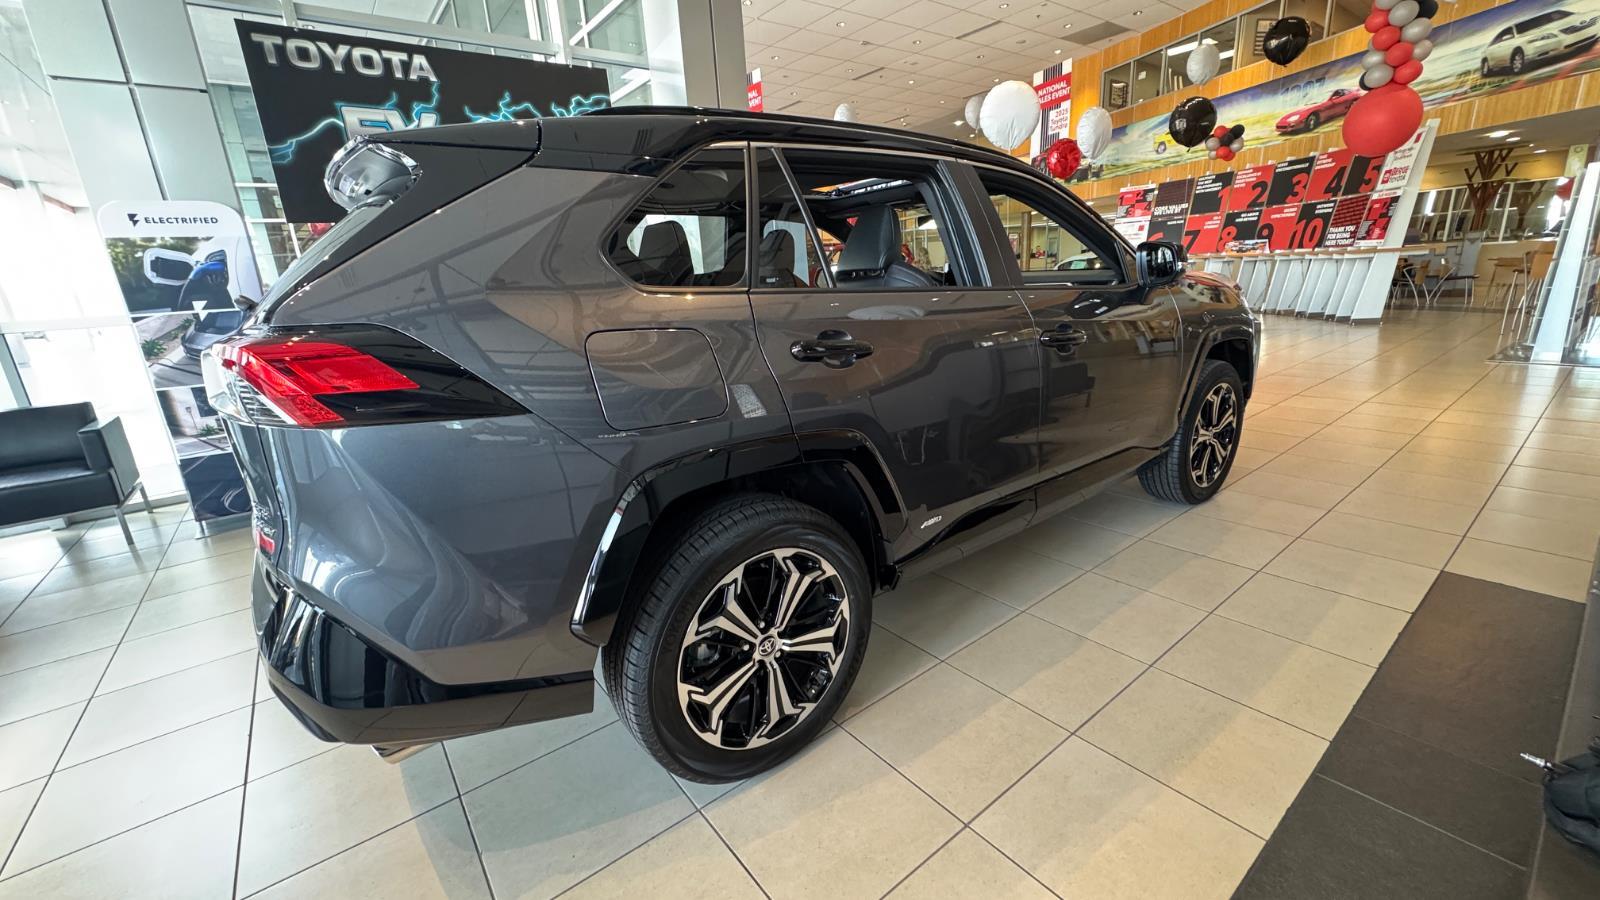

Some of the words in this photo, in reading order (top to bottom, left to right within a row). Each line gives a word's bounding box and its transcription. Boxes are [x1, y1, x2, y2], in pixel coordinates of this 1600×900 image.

[250, 32, 438, 82] TOYOTA
[1038, 80, 1068, 97] NATIONAL
[1052, 86, 1071, 101] EVENT
[1285, 173, 1310, 204] 3
[1323, 166, 1348, 197] 4
[1359, 156, 1385, 193] 5
[1217, 185, 1232, 212] 1
[1246, 181, 1269, 209] 2
[144, 216, 218, 224] ELECTRIFIED
[1292, 217, 1324, 249] 10
[1184, 230, 1201, 253] 7
[1217, 225, 1238, 252] 8
[1256, 223, 1274, 251] 9
